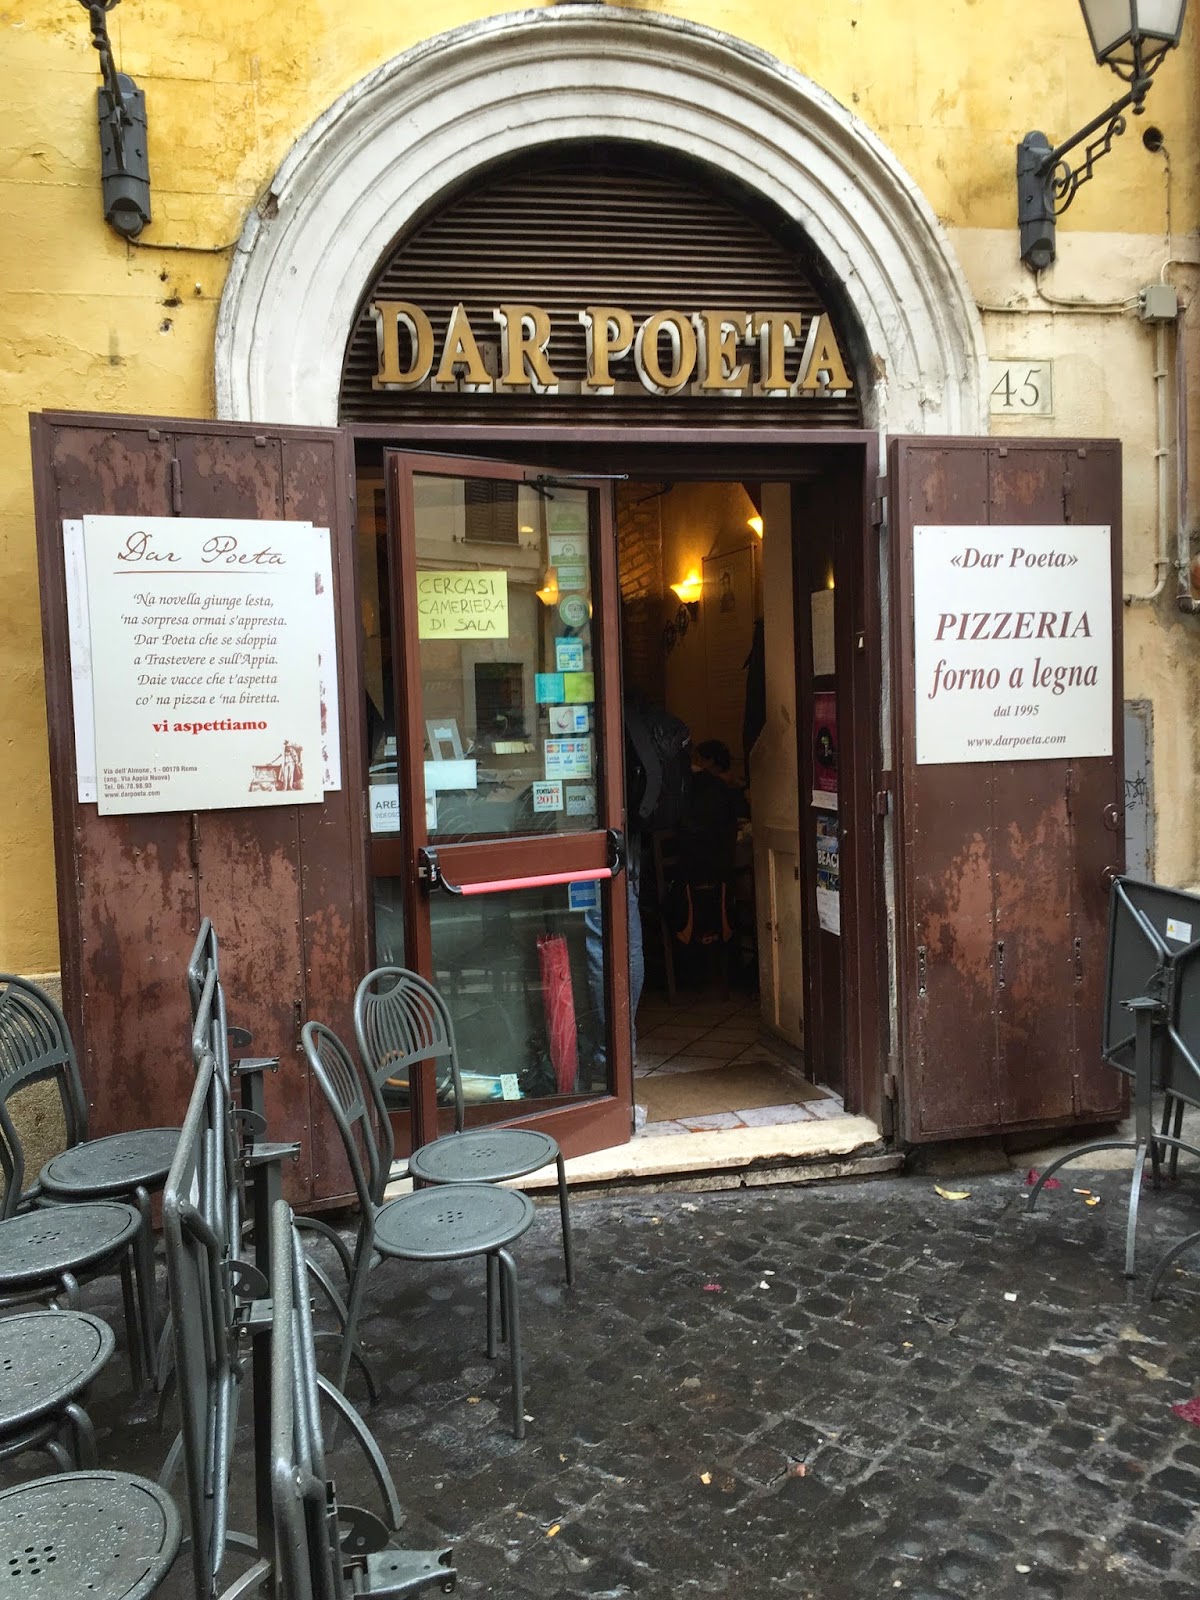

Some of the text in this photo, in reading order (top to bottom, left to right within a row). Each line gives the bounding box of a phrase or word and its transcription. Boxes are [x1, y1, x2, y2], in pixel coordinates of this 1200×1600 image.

[371, 300, 854, 396] DAR POETA
[991, 369, 1041, 407] 45
[117, 531, 287, 564] Dar Poeta
[950, 547, 1079, 568] «Dar Poeta»
[419, 578, 495, 596] CERCASI
[159, 593, 201, 605] novella
[201, 594, 242, 611] giunge
[245, 594, 274, 608] lesta,
[418, 599, 506, 615] CAMERIERA
[141, 616, 189, 629] sorpresa
[192, 615, 226, 625] ormai
[229, 615, 287, 630] s'appresta.
[429, 619, 496, 632] DI SALA
[933, 611, 1093, 641] PIZZERIA
[133, 633, 277, 649] Dar Poeta che se sdoppia
[133, 652, 278, 669] a Trastevere e sull'Appia.
[137, 672, 278, 688] Daie vacce che t'aspetta
[928, 656, 1098, 700] forno a legna
[135, 695, 153, 706] co'
[156, 696, 171, 705] na
[173, 694, 206, 709] pizza
[209, 695, 215, 704] e
[239, 691, 280, 704] biretta.
[993, 704, 1040, 717] dal 1995
[152, 718, 268, 735] vi aspettiamo
[967, 735, 1067, 748] www.darpoeta.com
[375, 800, 400, 810] ARE
